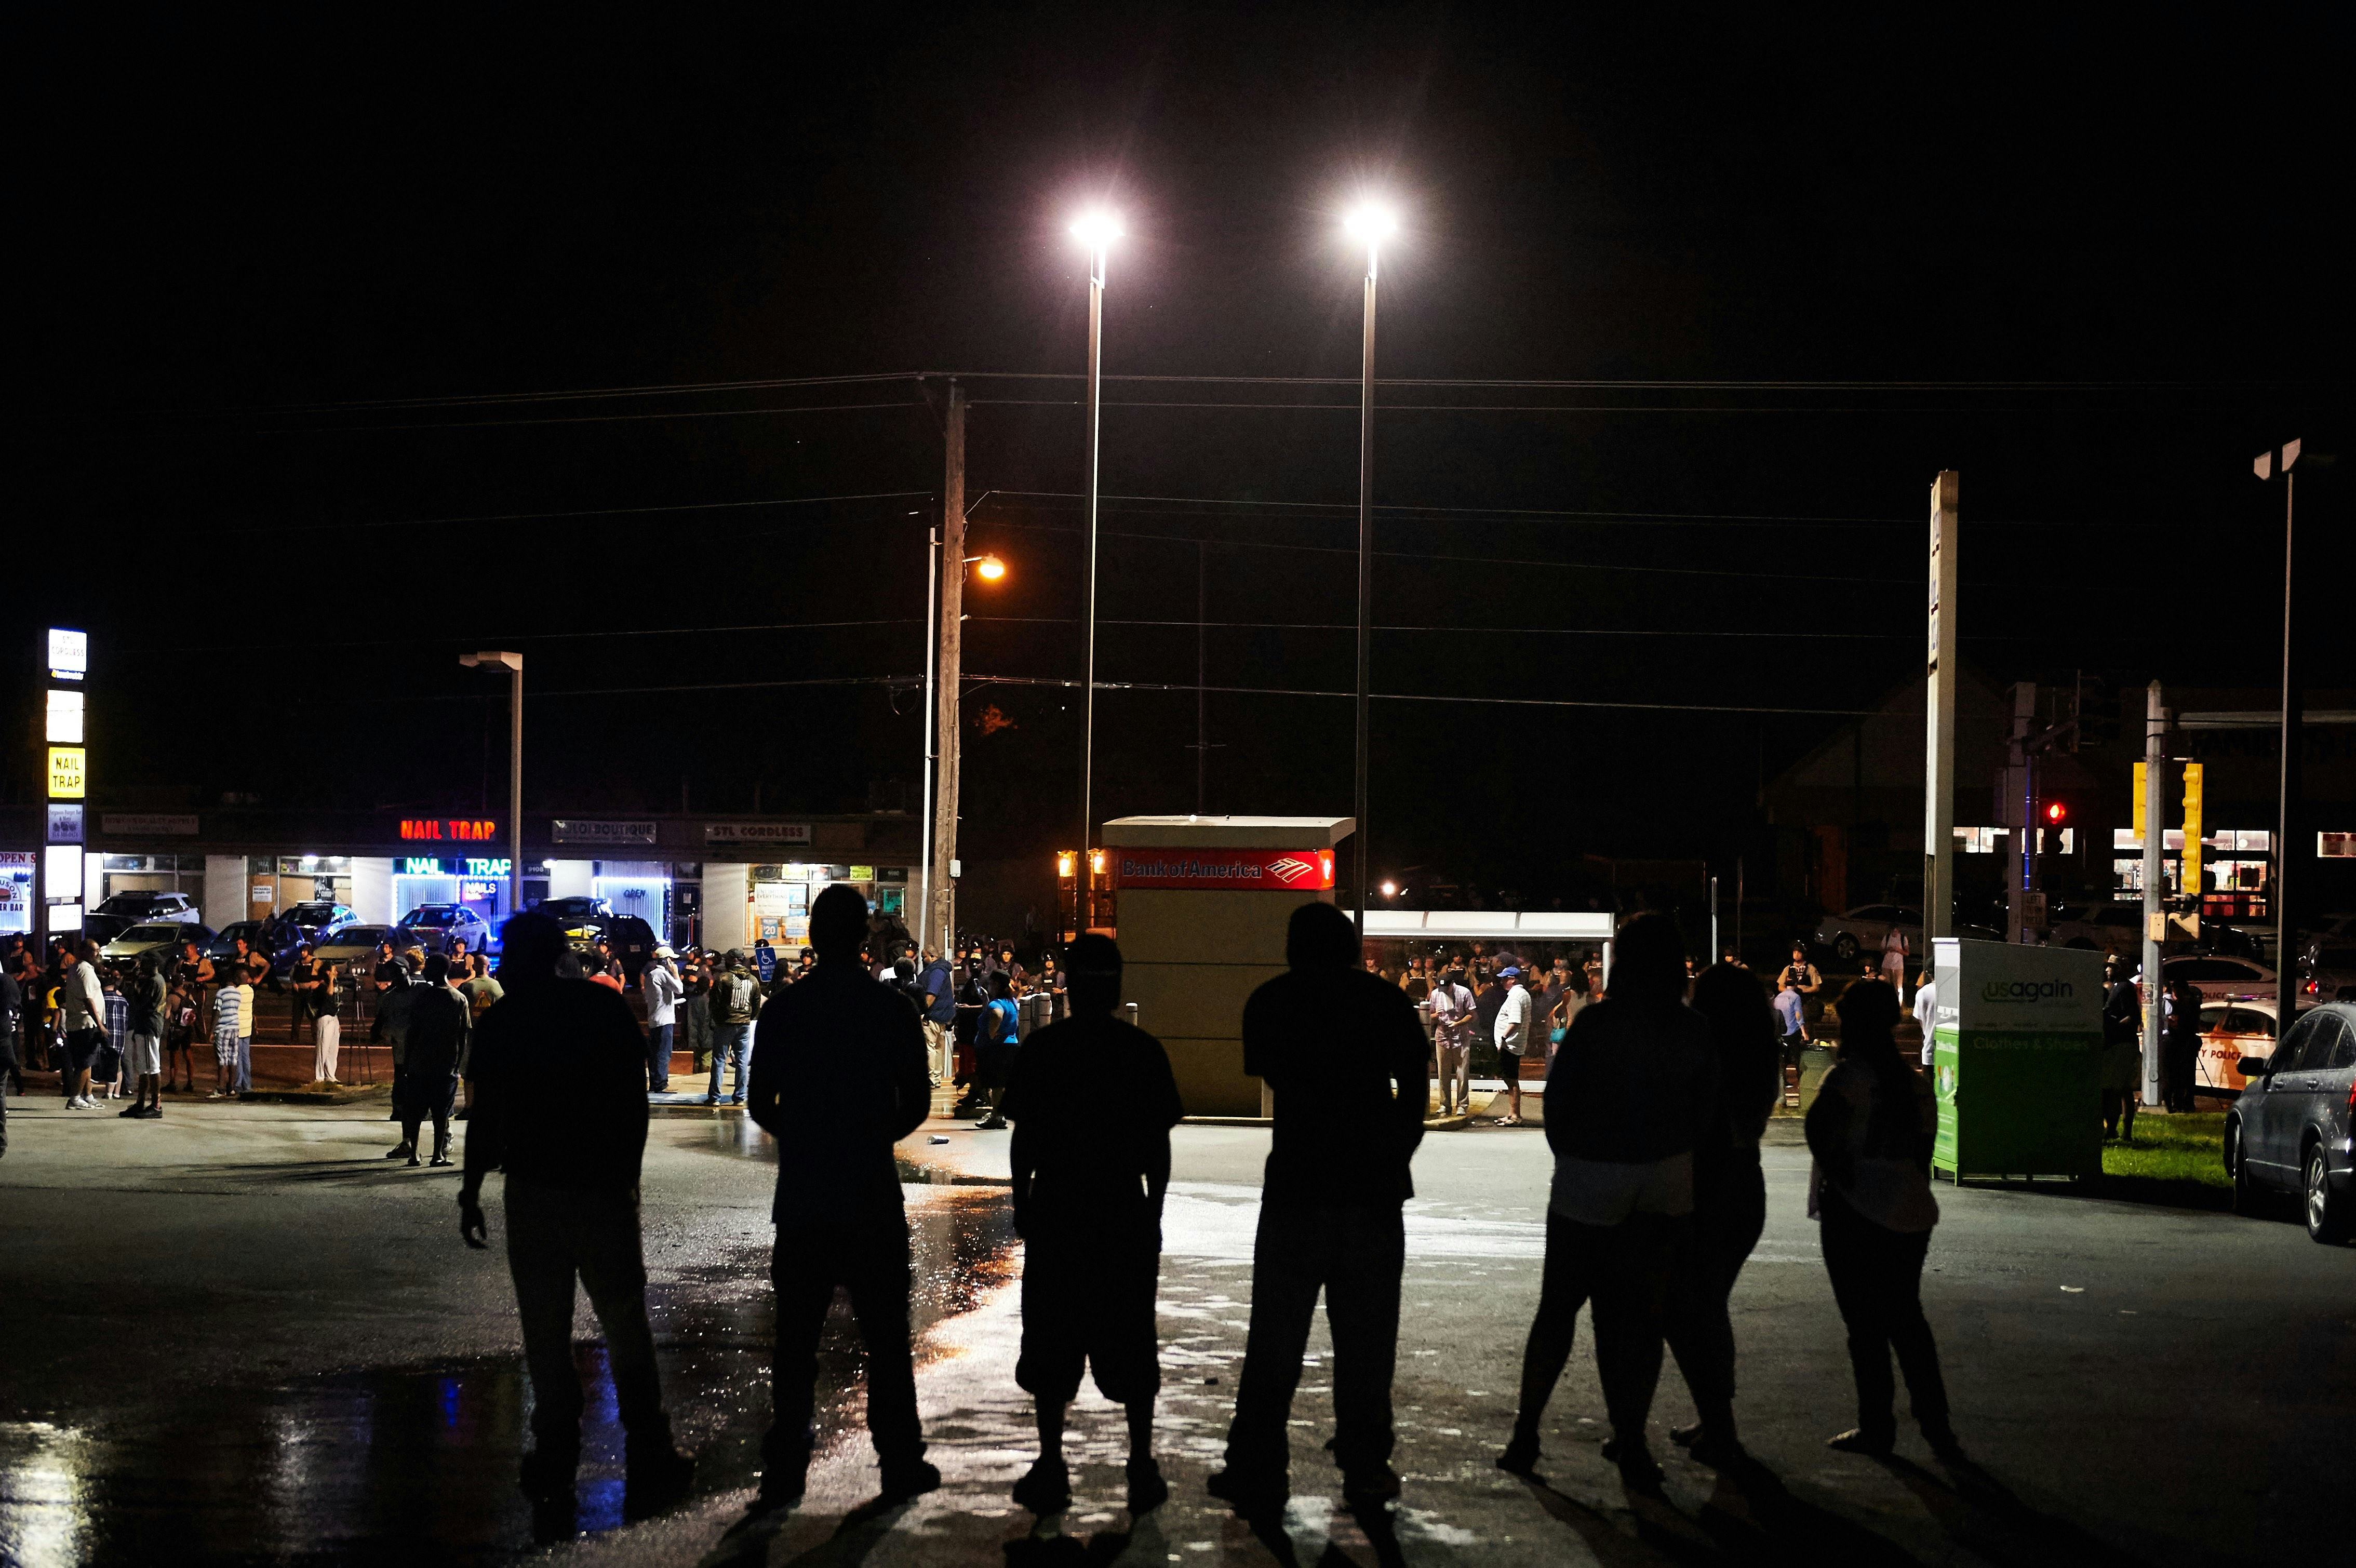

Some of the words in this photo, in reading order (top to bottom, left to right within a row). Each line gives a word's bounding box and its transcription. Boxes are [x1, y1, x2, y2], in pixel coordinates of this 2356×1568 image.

[56, 757, 79, 770] NAIL
[53, 775, 80, 788] TRAP
[400, 820, 442, 839] NAIL
[449, 821, 496, 840] TRAP
[595, 824, 653, 835] BOUTIQUE
[714, 826, 735, 836] STL
[740, 826, 803, 837] CORDLESS
[406, 857, 445, 874] NAIL
[465, 858, 511, 875] TRAP
[1123, 859, 1166, 878] Bank
[1169, 860, 1187, 878] of
[1190, 860, 1262, 878] America
[465, 883, 497, 894] NAILS
[623, 888, 646, 898] OPEN
[1984, 979, 2073, 1002] usagain
[1973, 1037, 2029, 1050] Clothes
[2210, 1050, 2242, 1060] POLICE
